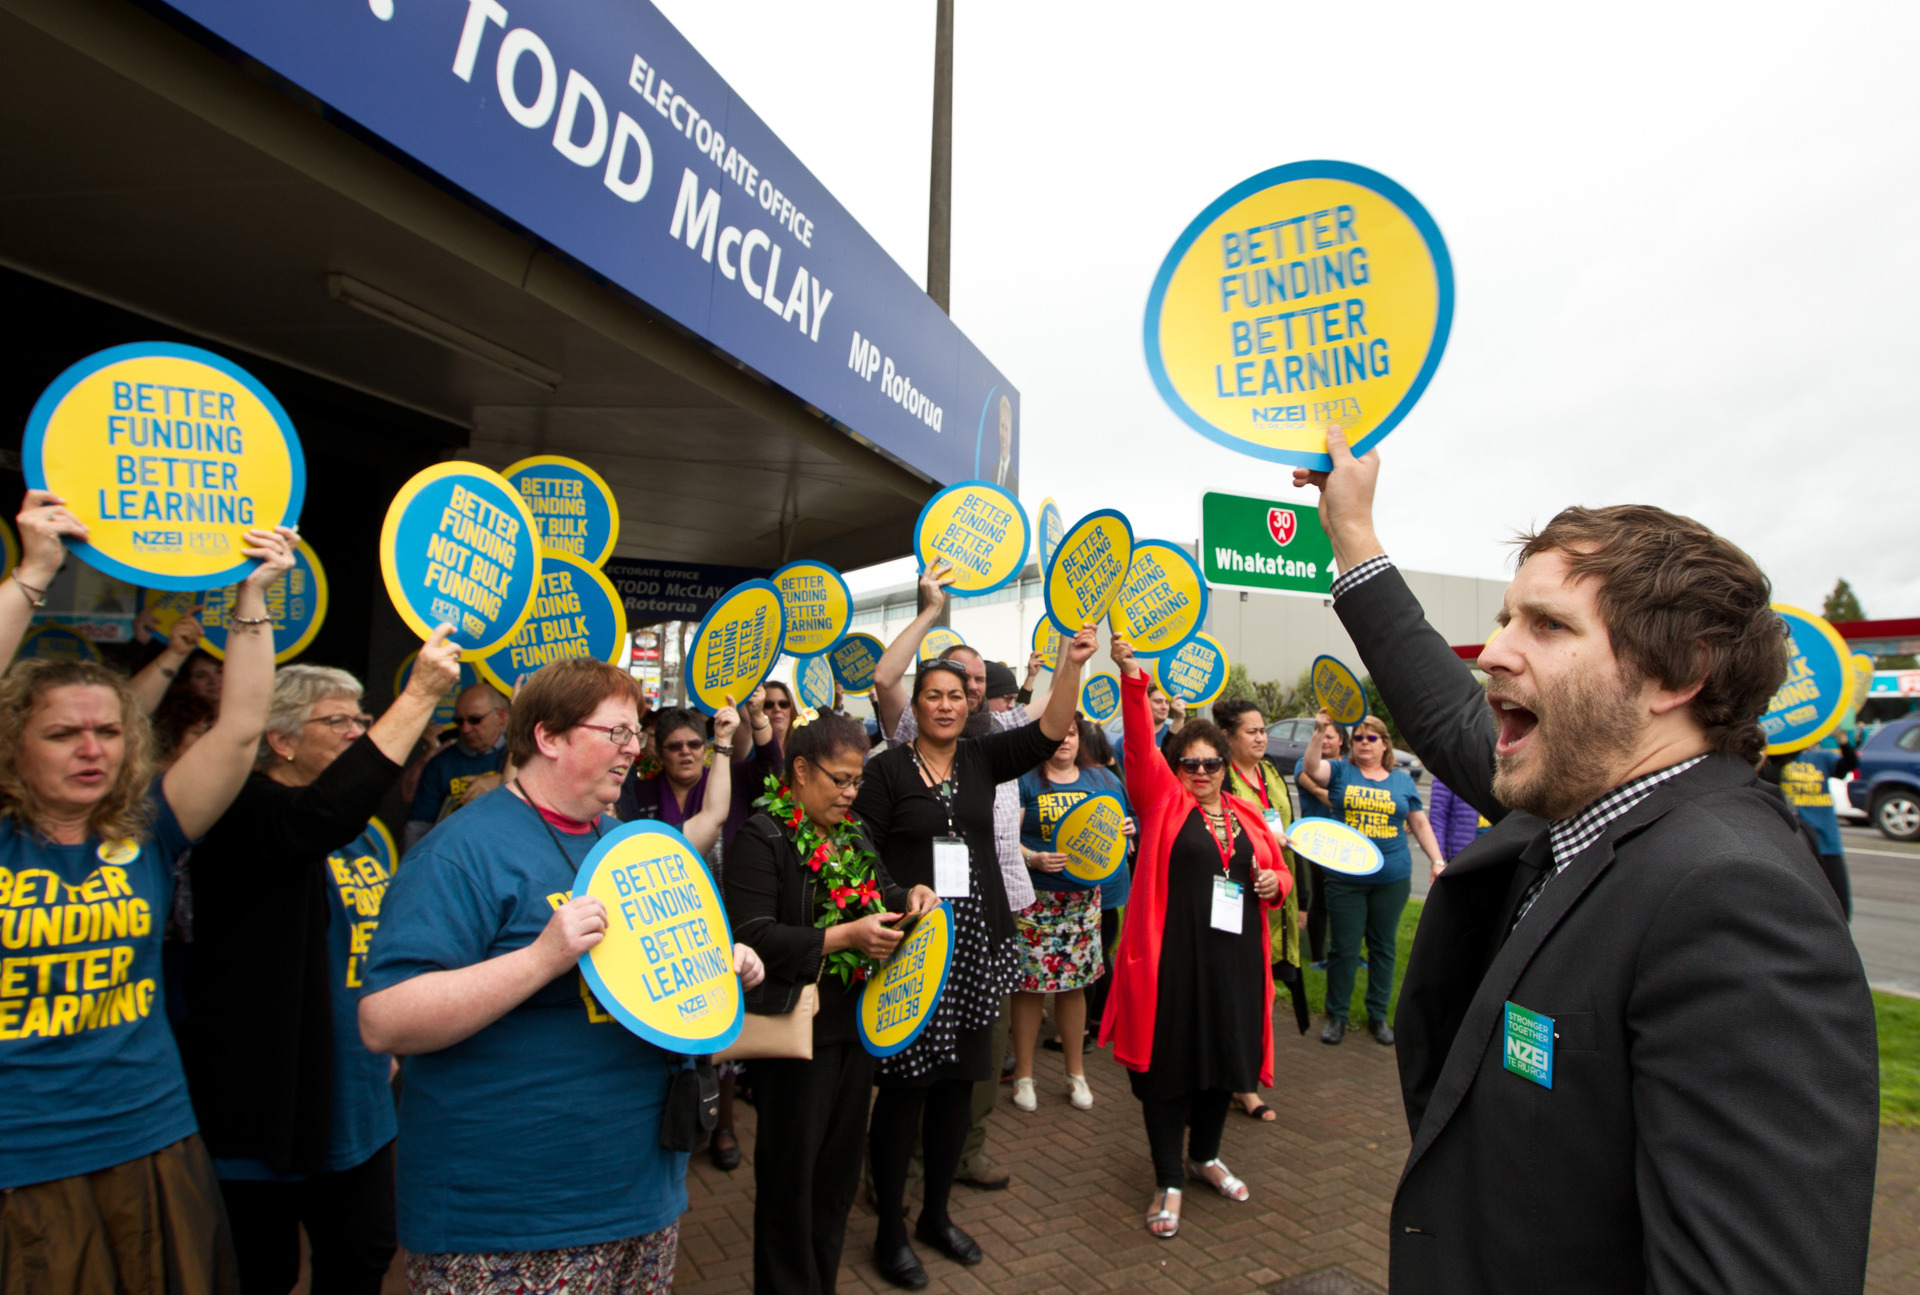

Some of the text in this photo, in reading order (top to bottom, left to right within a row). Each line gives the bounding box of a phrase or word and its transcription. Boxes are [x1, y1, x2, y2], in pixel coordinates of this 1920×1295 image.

[628, 54, 814, 248] ELECTORATE OFFICE
[452, 0, 943, 433] TODD McCLAY MP Rotorua
[1221, 204, 1359, 271] BETTER
[1218, 246, 1370, 313] FUNDING
[1230, 298, 1369, 358] BETTER
[1214, 338, 1391, 398] LEARNING
[113, 380, 236, 422] BETTER
[1252, 397, 1363, 423] NZEI PPTA
[107, 415, 243, 455] FUNDING
[116, 454, 238, 491] BETTER
[521, 477, 583, 497] BETTER
[98, 488, 254, 525] LEARNING
[450, 483, 520, 544] BETTER
[952, 506, 1006, 544] FUNDING
[963, 493, 1012, 528] BETTER
[1273, 511, 1291, 529] 30
[132, 530, 183, 545] NZEI
[439, 508, 517, 570] FUNDING
[539, 535, 585, 554] NDING
[548, 517, 588, 536] BULK
[945, 522, 994, 558] BETTER
[1278, 528, 1287, 541] A
[426, 533, 512, 600] NOT BULK
[931, 533, 992, 576] LEARNING
[1061, 525, 1105, 574] BETTER
[1066, 536, 1111, 589] FUNDING
[1215, 547, 1317, 579] Whakatane
[538, 571, 573, 595] TER
[602, 565, 700, 580] ECTORATE OFFICE
[616, 579, 724, 599] TODD McCLAY
[781, 575, 824, 591] BETTER
[1075, 553, 1114, 602] BETTER
[1118, 564, 1166, 608] FUNDING
[1122, 552, 1156, 589] TTER
[424, 561, 502, 622] FUNDING
[527, 592, 581, 619] DING
[624, 596, 697, 613] Rotorua
[782, 589, 827, 604] FUNDING
[1076, 560, 1122, 620] LEARNING
[1125, 581, 1174, 621] BETTER
[541, 615, 590, 643] BULK
[784, 604, 825, 619] BETTER
[785, 617, 833, 633] EARNING
[1126, 591, 1190, 640] LEARNING
[510, 638, 590, 669] FUNDING
[704, 627, 724, 690] BETTER
[720, 619, 739, 688] FUNDING
[737, 617, 753, 679] BETTER
[747, 604, 767, 681] LEARNING
[1176, 649, 1214, 673] FUNDING
[1168, 670, 1205, 694] FUNDING
[1170, 659, 1211, 684] NOT BULK
[1344, 796, 1396, 815] FUNDING
[1345, 785, 1391, 801] BETTER
[1086, 814, 1119, 842] FUNDING
[1095, 802, 1121, 827] BETTER
[1345, 810, 1389, 825] BETTER
[1346, 823, 1398, 838] EARNING
[1066, 836, 1110, 869] LEARNING
[1079, 827, 1112, 855] BETTER
[0, 866, 133, 908] BETTER
[611, 854, 689, 898] BETTER
[620, 883, 703, 931] FUNDING
[639, 917, 713, 965] BETTER
[0, 945, 134, 998] ETTER
[641, 946, 728, 1003] LEARNING
[884, 951, 926, 987] BETTER
[0, 978, 156, 1041] EARNING
[676, 994, 707, 1017] NZEI
[877, 973, 925, 1012] FUNDING
[876, 996, 920, 1033] BETTER
[1508, 1011, 1548, 1034] STRONGER
[1508, 1020, 1548, 1044] TOGETHER
[1507, 1035, 1548, 1072] NZEI
[1507, 1055, 1517, 1068] TE
[1530, 1067, 1547, 1080] ROA
